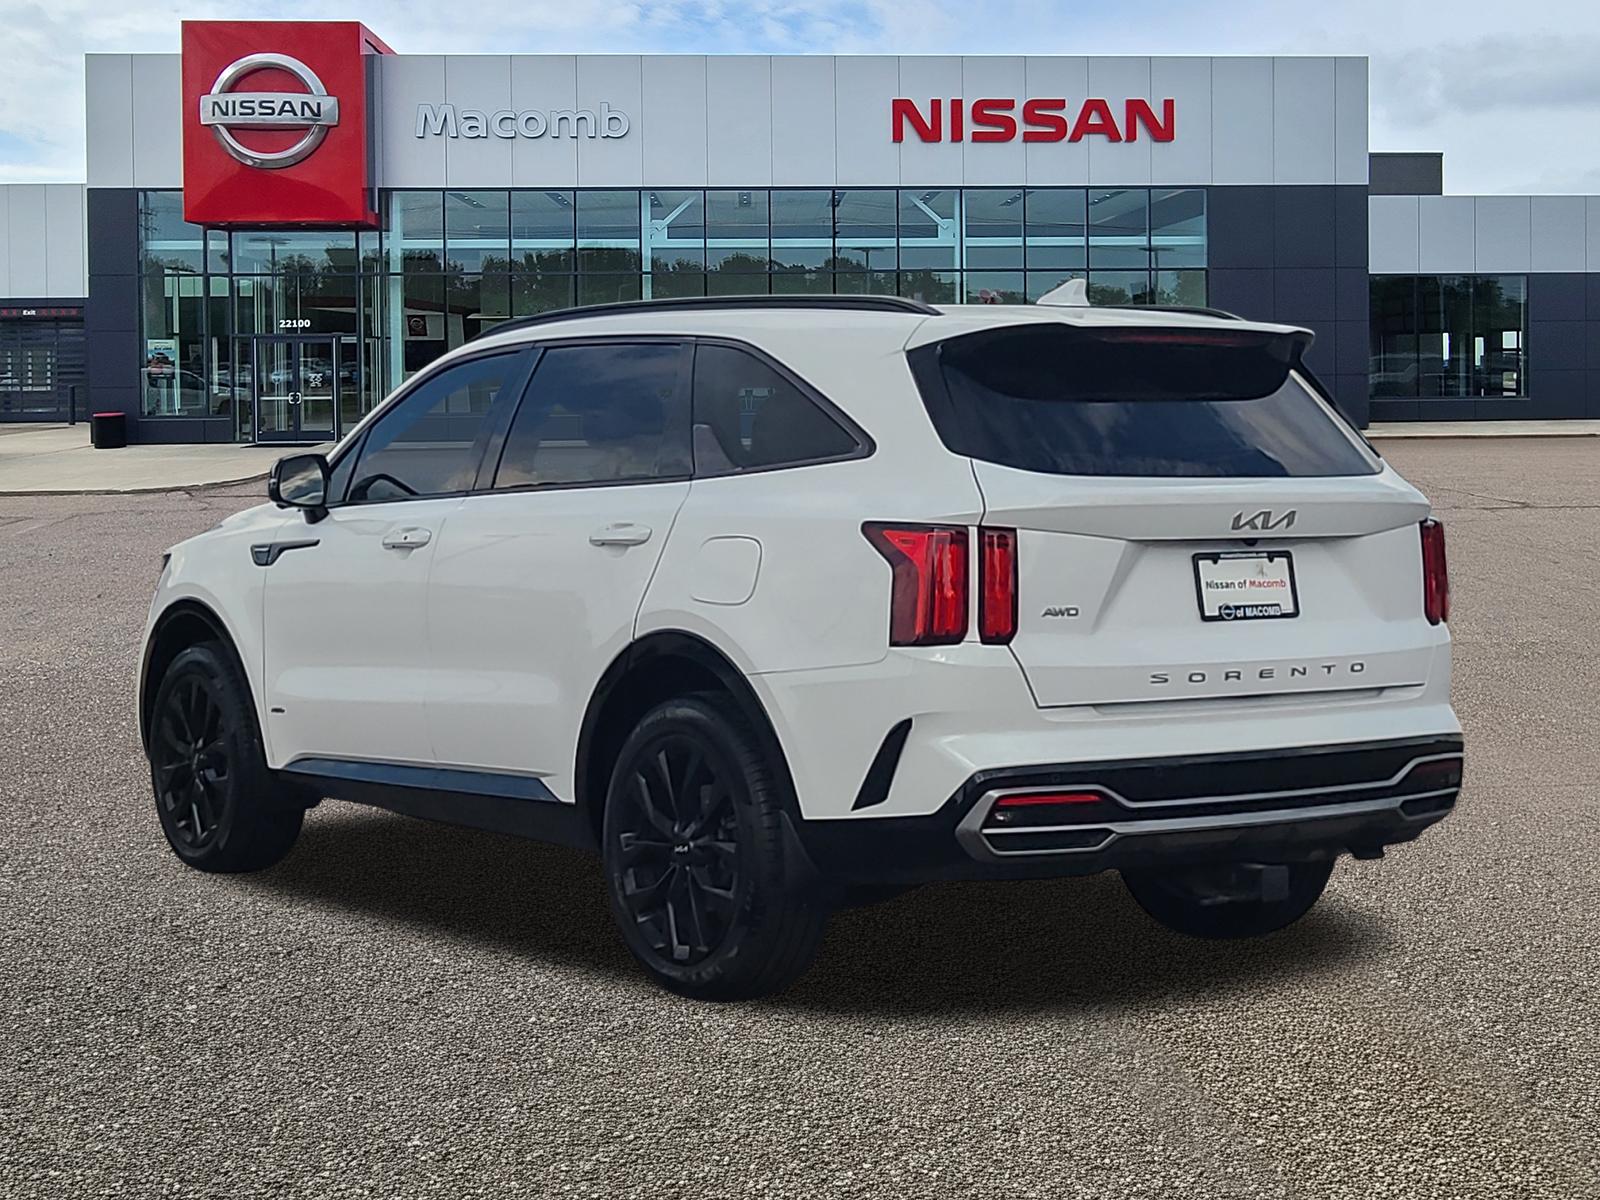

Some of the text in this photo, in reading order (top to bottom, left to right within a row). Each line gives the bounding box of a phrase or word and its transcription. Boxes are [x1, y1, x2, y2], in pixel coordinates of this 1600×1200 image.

[211, 99, 322, 118] NISSAN
[415, 102, 630, 139] Macomb
[892, 98, 1175, 143] NISSAN
[279, 319, 311, 328] 22100
[1205, 579, 1287, 590] Nissan of Macomb
[1041, 607, 1079, 618] AWD
[1245, 605, 1282, 617] MACOMB
[1149, 662, 1365, 685] SORENTO
